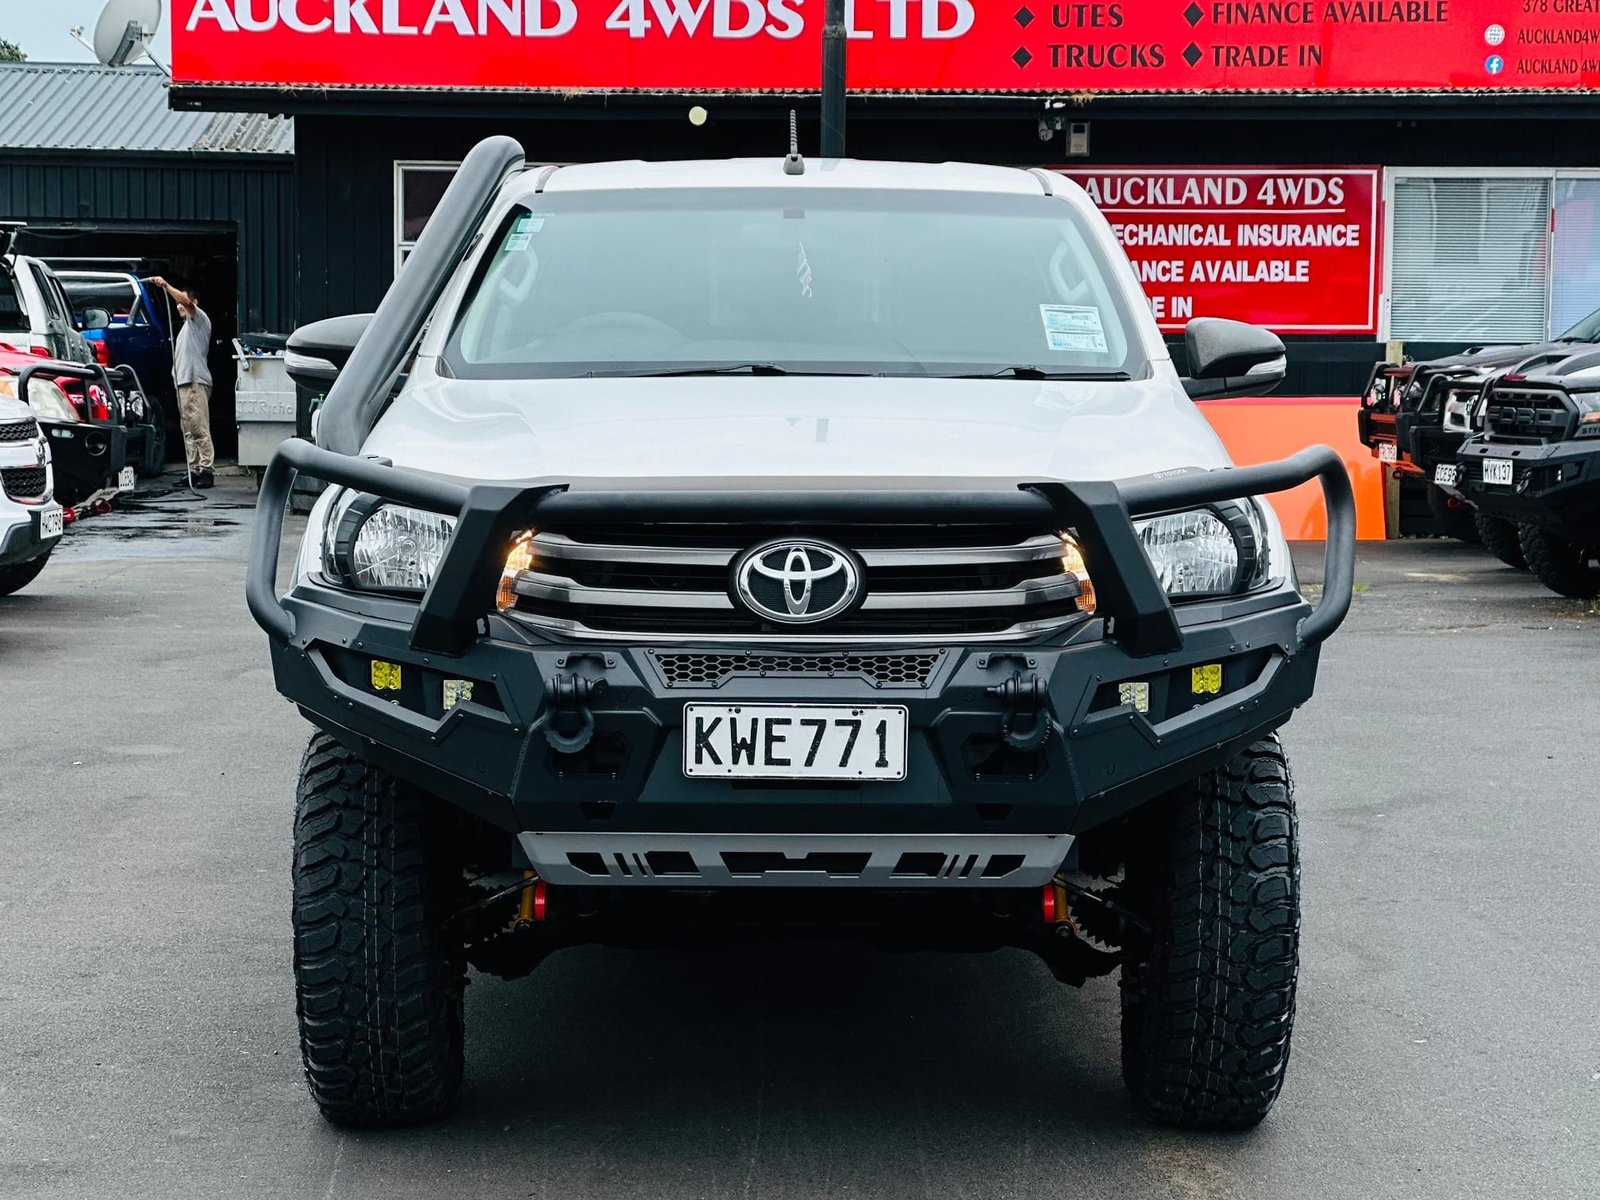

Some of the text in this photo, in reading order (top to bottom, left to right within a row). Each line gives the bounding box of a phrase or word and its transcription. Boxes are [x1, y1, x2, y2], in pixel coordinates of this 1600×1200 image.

[1052, 3, 1123, 28] UTES
[1212, 0, 1449, 24] FINANCE AVAILABLE
[1523, 0, 1548, 13] 378
[185, 0, 976, 39] AUCKLAND 4WDS LTD
[1518, 29, 1600, 44] AUCKLAND4W
[1048, 43, 1165, 68] TRUCKS
[1212, 45, 1322, 67] TRADE IN
[1517, 59, 1578, 74] AUCKLAND
[1085, 177, 1345, 206] AUCKLAND 4WDS
[1111, 223, 1360, 247] ECHANICAL INSURANCE
[1190, 260, 1309, 282] AVAILABLE
[1171, 296, 1193, 318] IN
[1582, 427, 1600, 435] STY
[694, 716, 889, 768] KWE771
